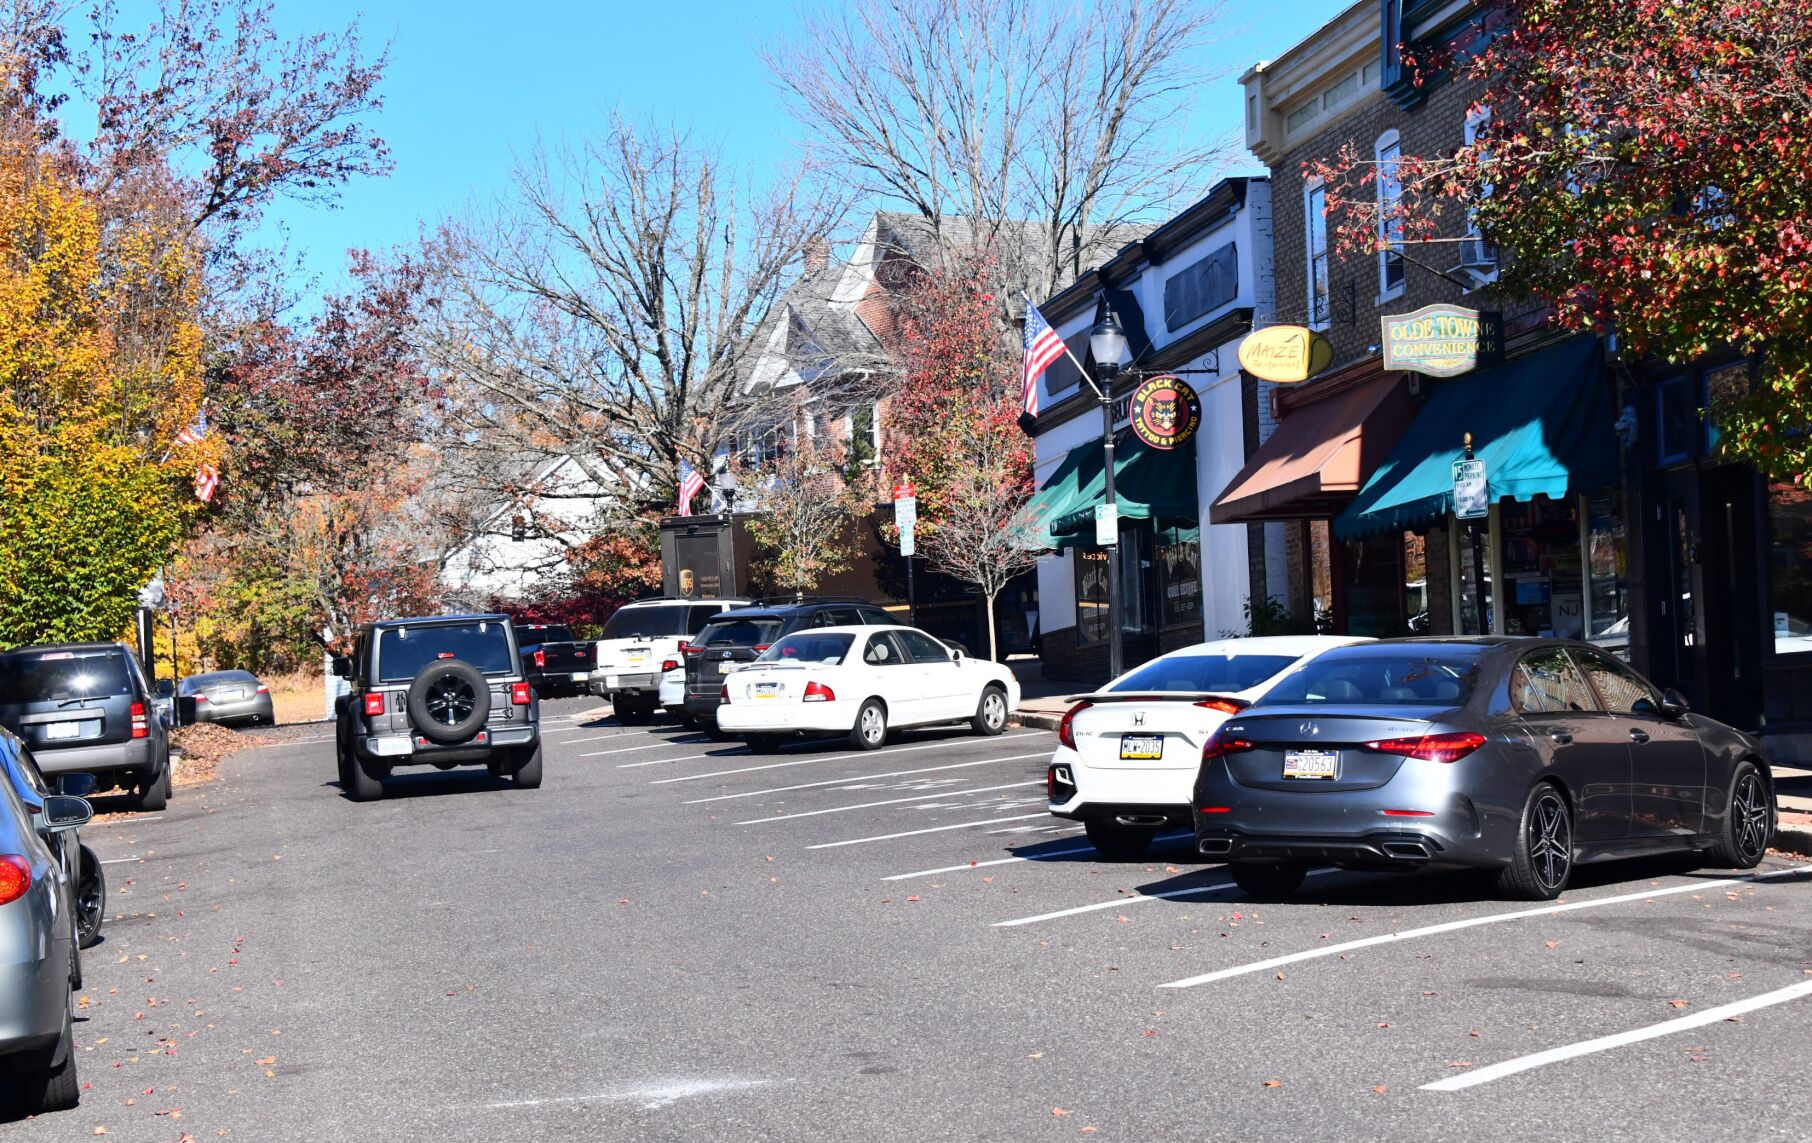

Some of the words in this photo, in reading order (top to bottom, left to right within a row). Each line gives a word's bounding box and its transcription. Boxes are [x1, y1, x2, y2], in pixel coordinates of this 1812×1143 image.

[1391, 318, 1434, 340] OLDE
[1436, 316, 1495, 338] TOWNE
[1247, 342, 1300, 359] MAIZE
[1393, 341, 1495, 357] CONVENIENCE
[1136, 379, 1172, 402] BLACK
[1174, 382, 1196, 401] CAT
[1135, 416, 1159, 444] TATTOO
[1160, 437, 1167, 445] &
[1168, 416, 1198, 445] PIERCING
[1455, 463, 1463, 480] 15
